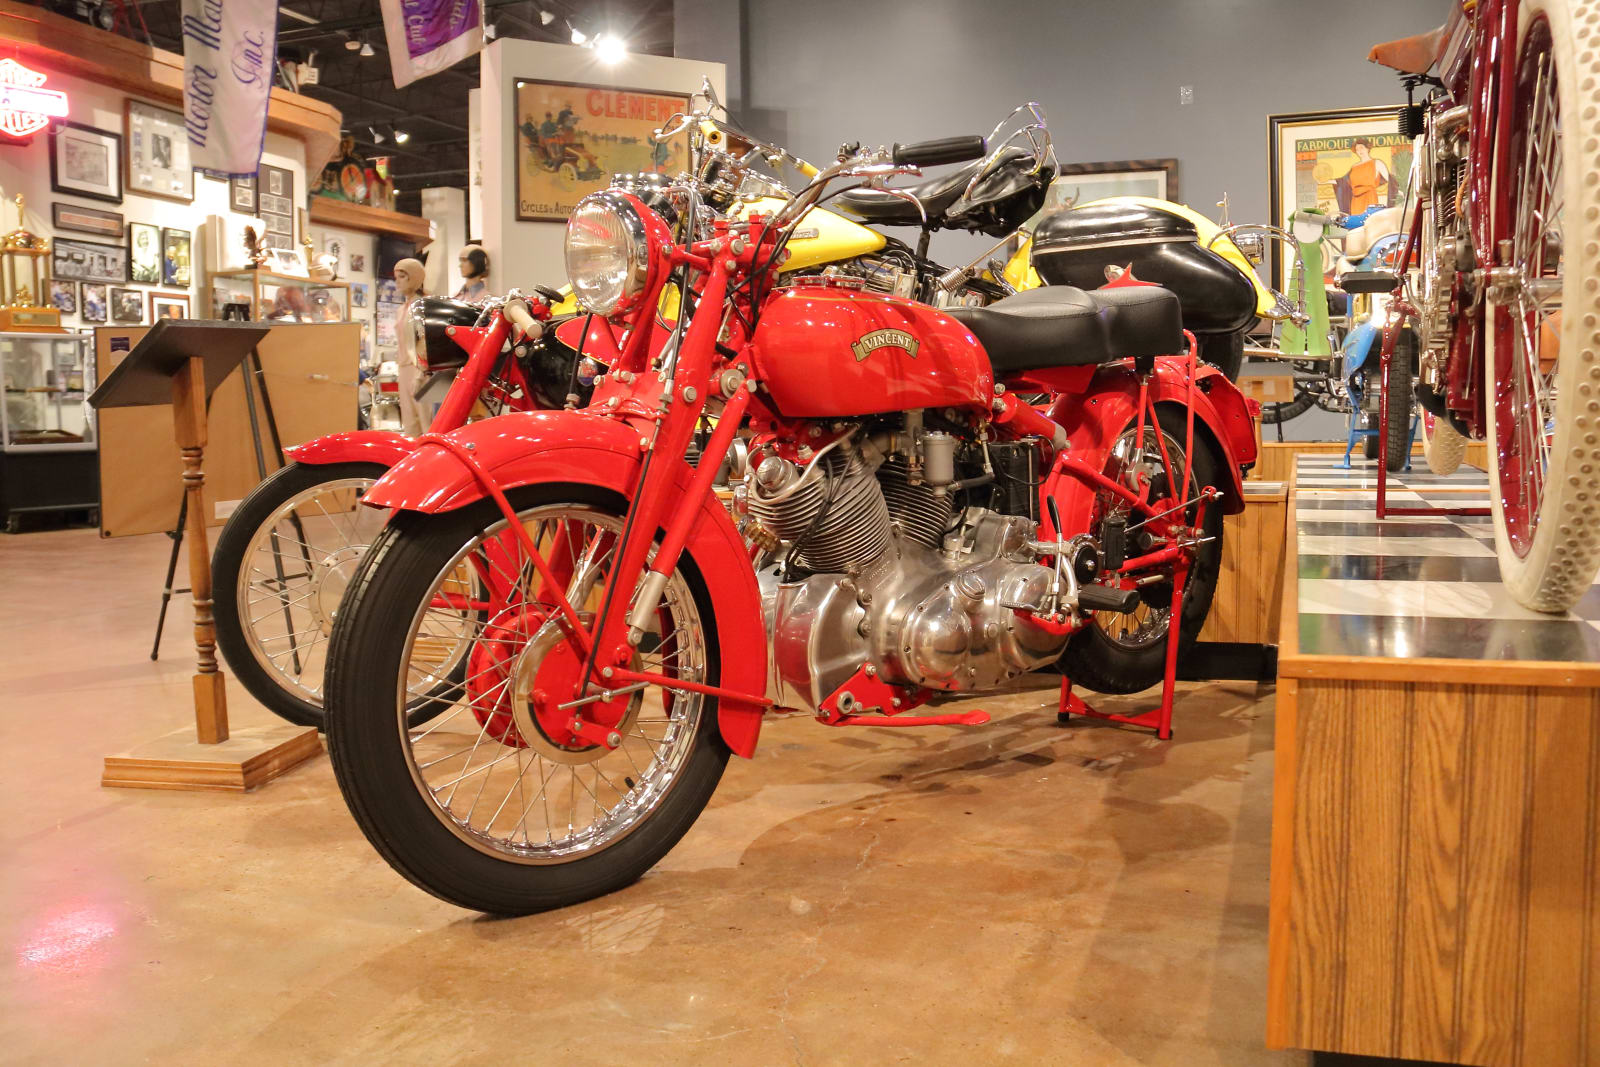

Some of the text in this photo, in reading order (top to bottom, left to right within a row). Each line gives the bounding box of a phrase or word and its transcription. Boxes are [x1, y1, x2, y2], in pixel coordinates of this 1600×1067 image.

[184, 64, 217, 148] Motor
[1297, 139, 1351, 152] FABRIQUE
[521, 200, 548, 213] CYCLES
[865, 333, 911, 349] VINCENT
